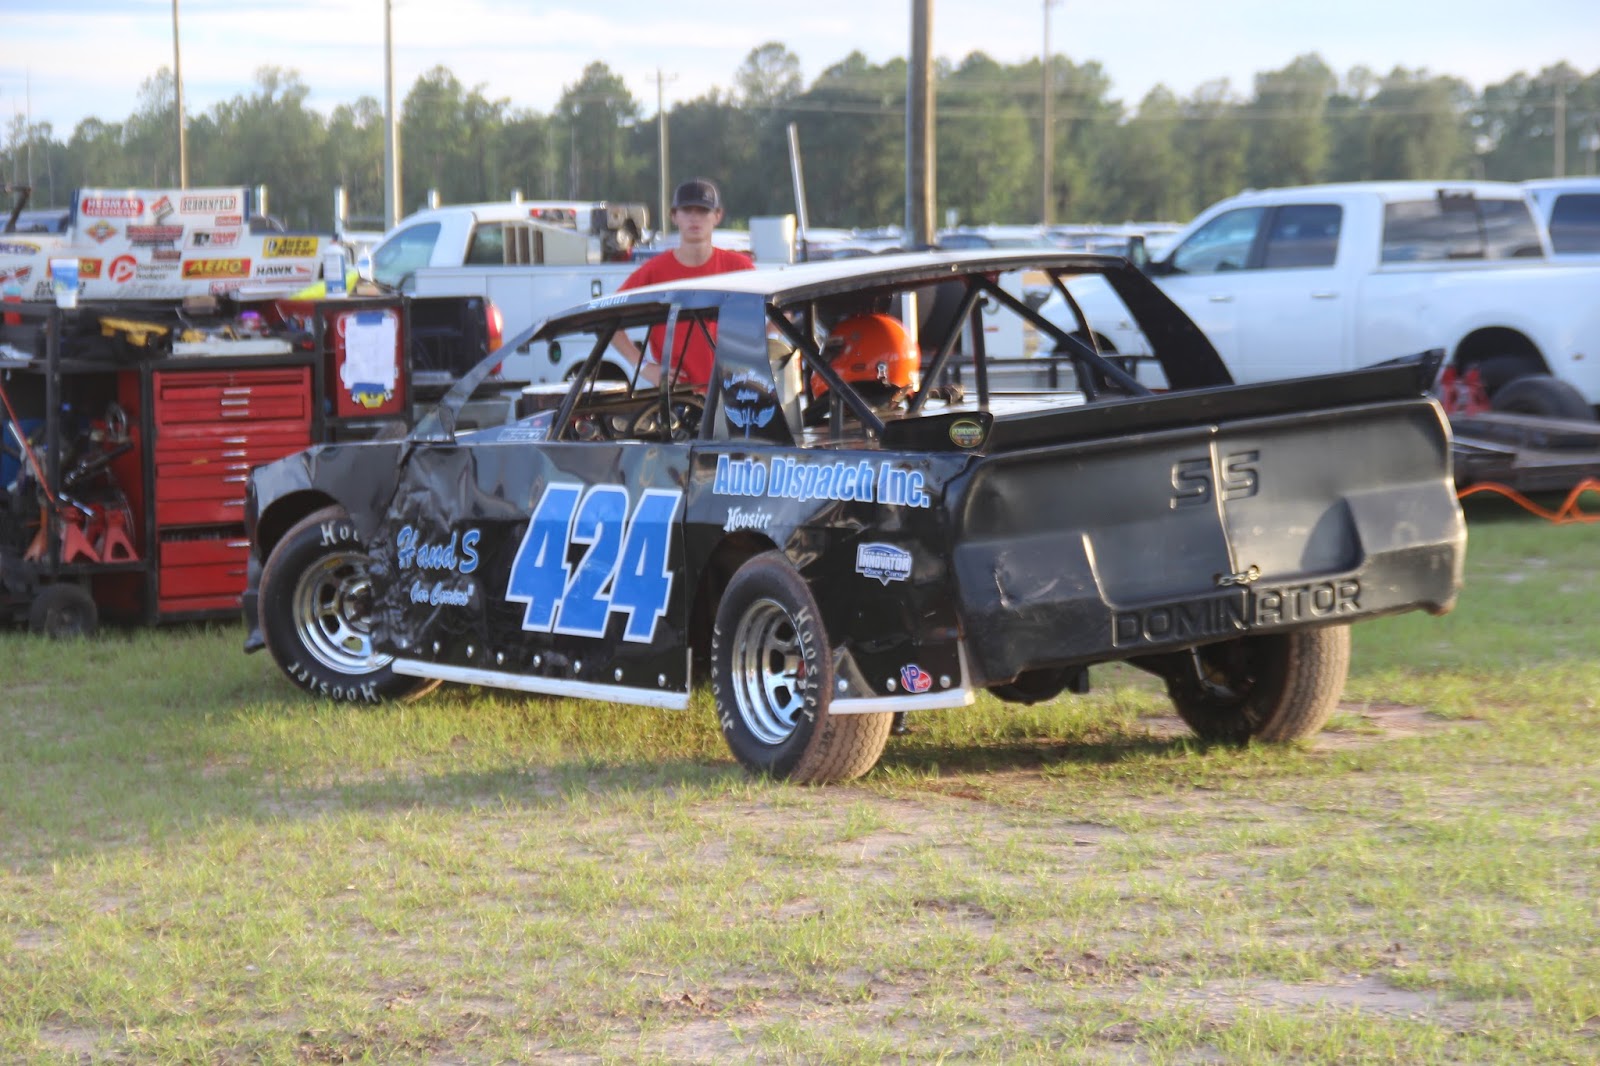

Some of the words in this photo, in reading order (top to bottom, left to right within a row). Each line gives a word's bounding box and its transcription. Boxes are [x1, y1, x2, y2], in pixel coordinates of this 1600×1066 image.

[188, 259, 243, 274] AERO
[256, 265, 293, 276] HAWK
[712, 453, 766, 498] Auto
[766, 456, 874, 504] Dispatch
[877, 462, 931, 508] Inc.
[723, 506, 772, 533] Hoosier
[416, 530, 458, 571] and
[459, 528, 481, 574] S
[505, 482, 684, 644] 424
[858, 546, 910, 572] INNOVATOR
[864, 568, 883, 576] Race
[1111, 577, 1362, 649] DOMINATOR
[900, 664, 920, 692] VP
